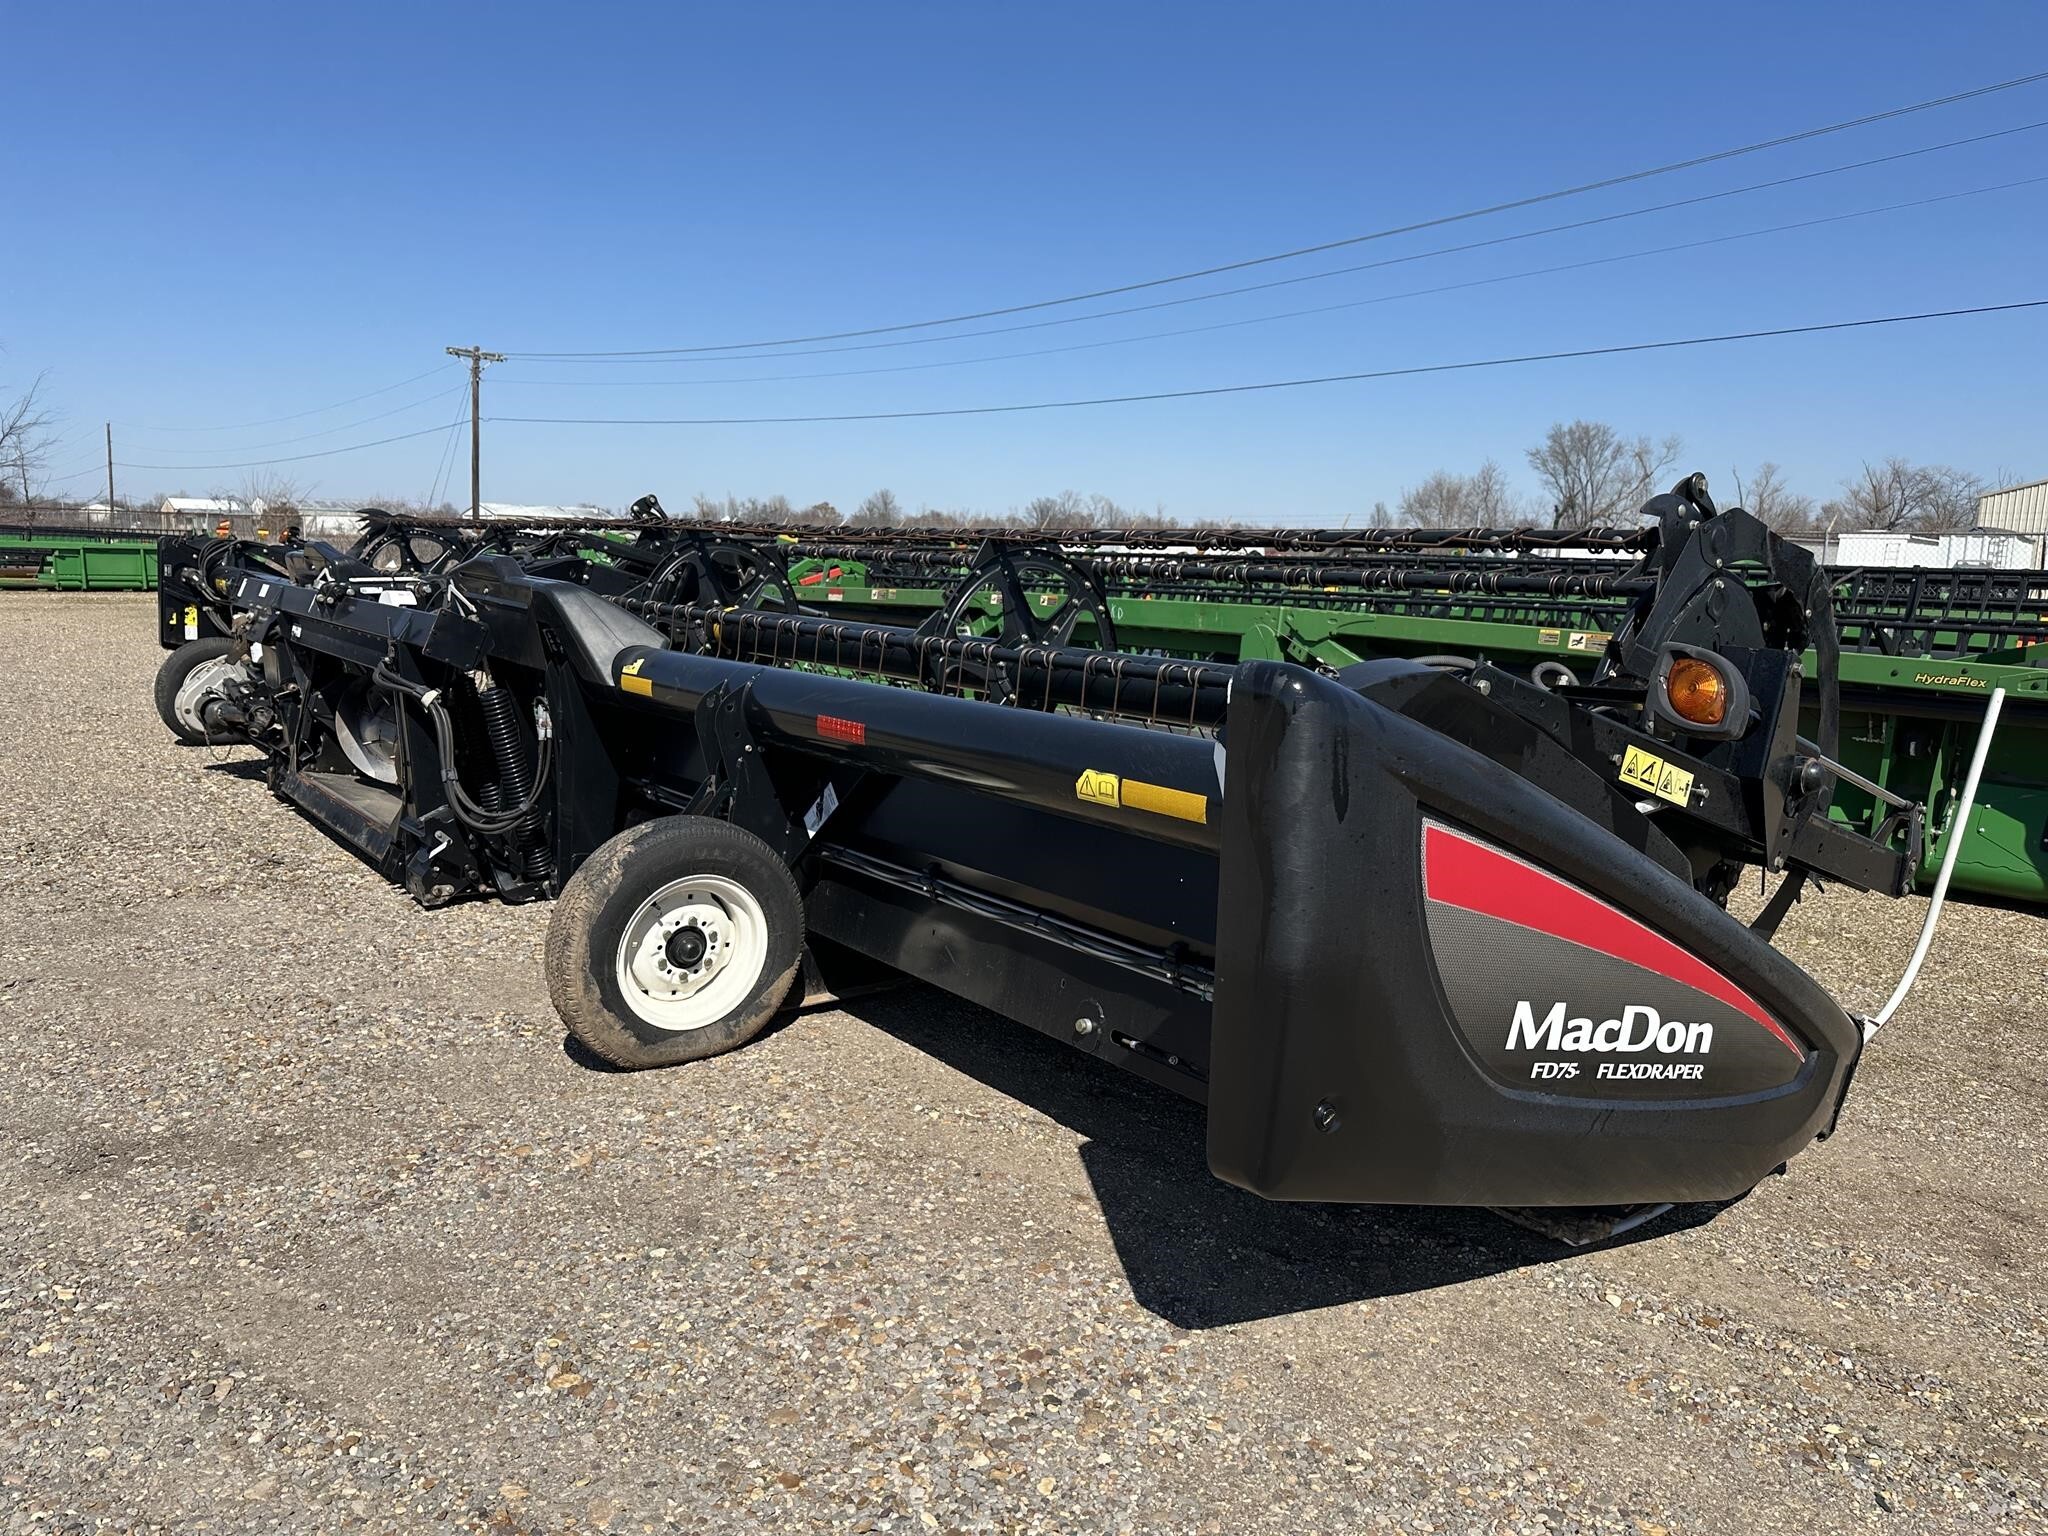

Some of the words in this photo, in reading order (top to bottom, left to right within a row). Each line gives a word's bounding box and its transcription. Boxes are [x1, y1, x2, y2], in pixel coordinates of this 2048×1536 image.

[1914, 673, 1988, 688] HydraFlex
[1505, 1001, 1713, 1053] MacDon
[1597, 1063, 1704, 1080] FLEXDRAPER
